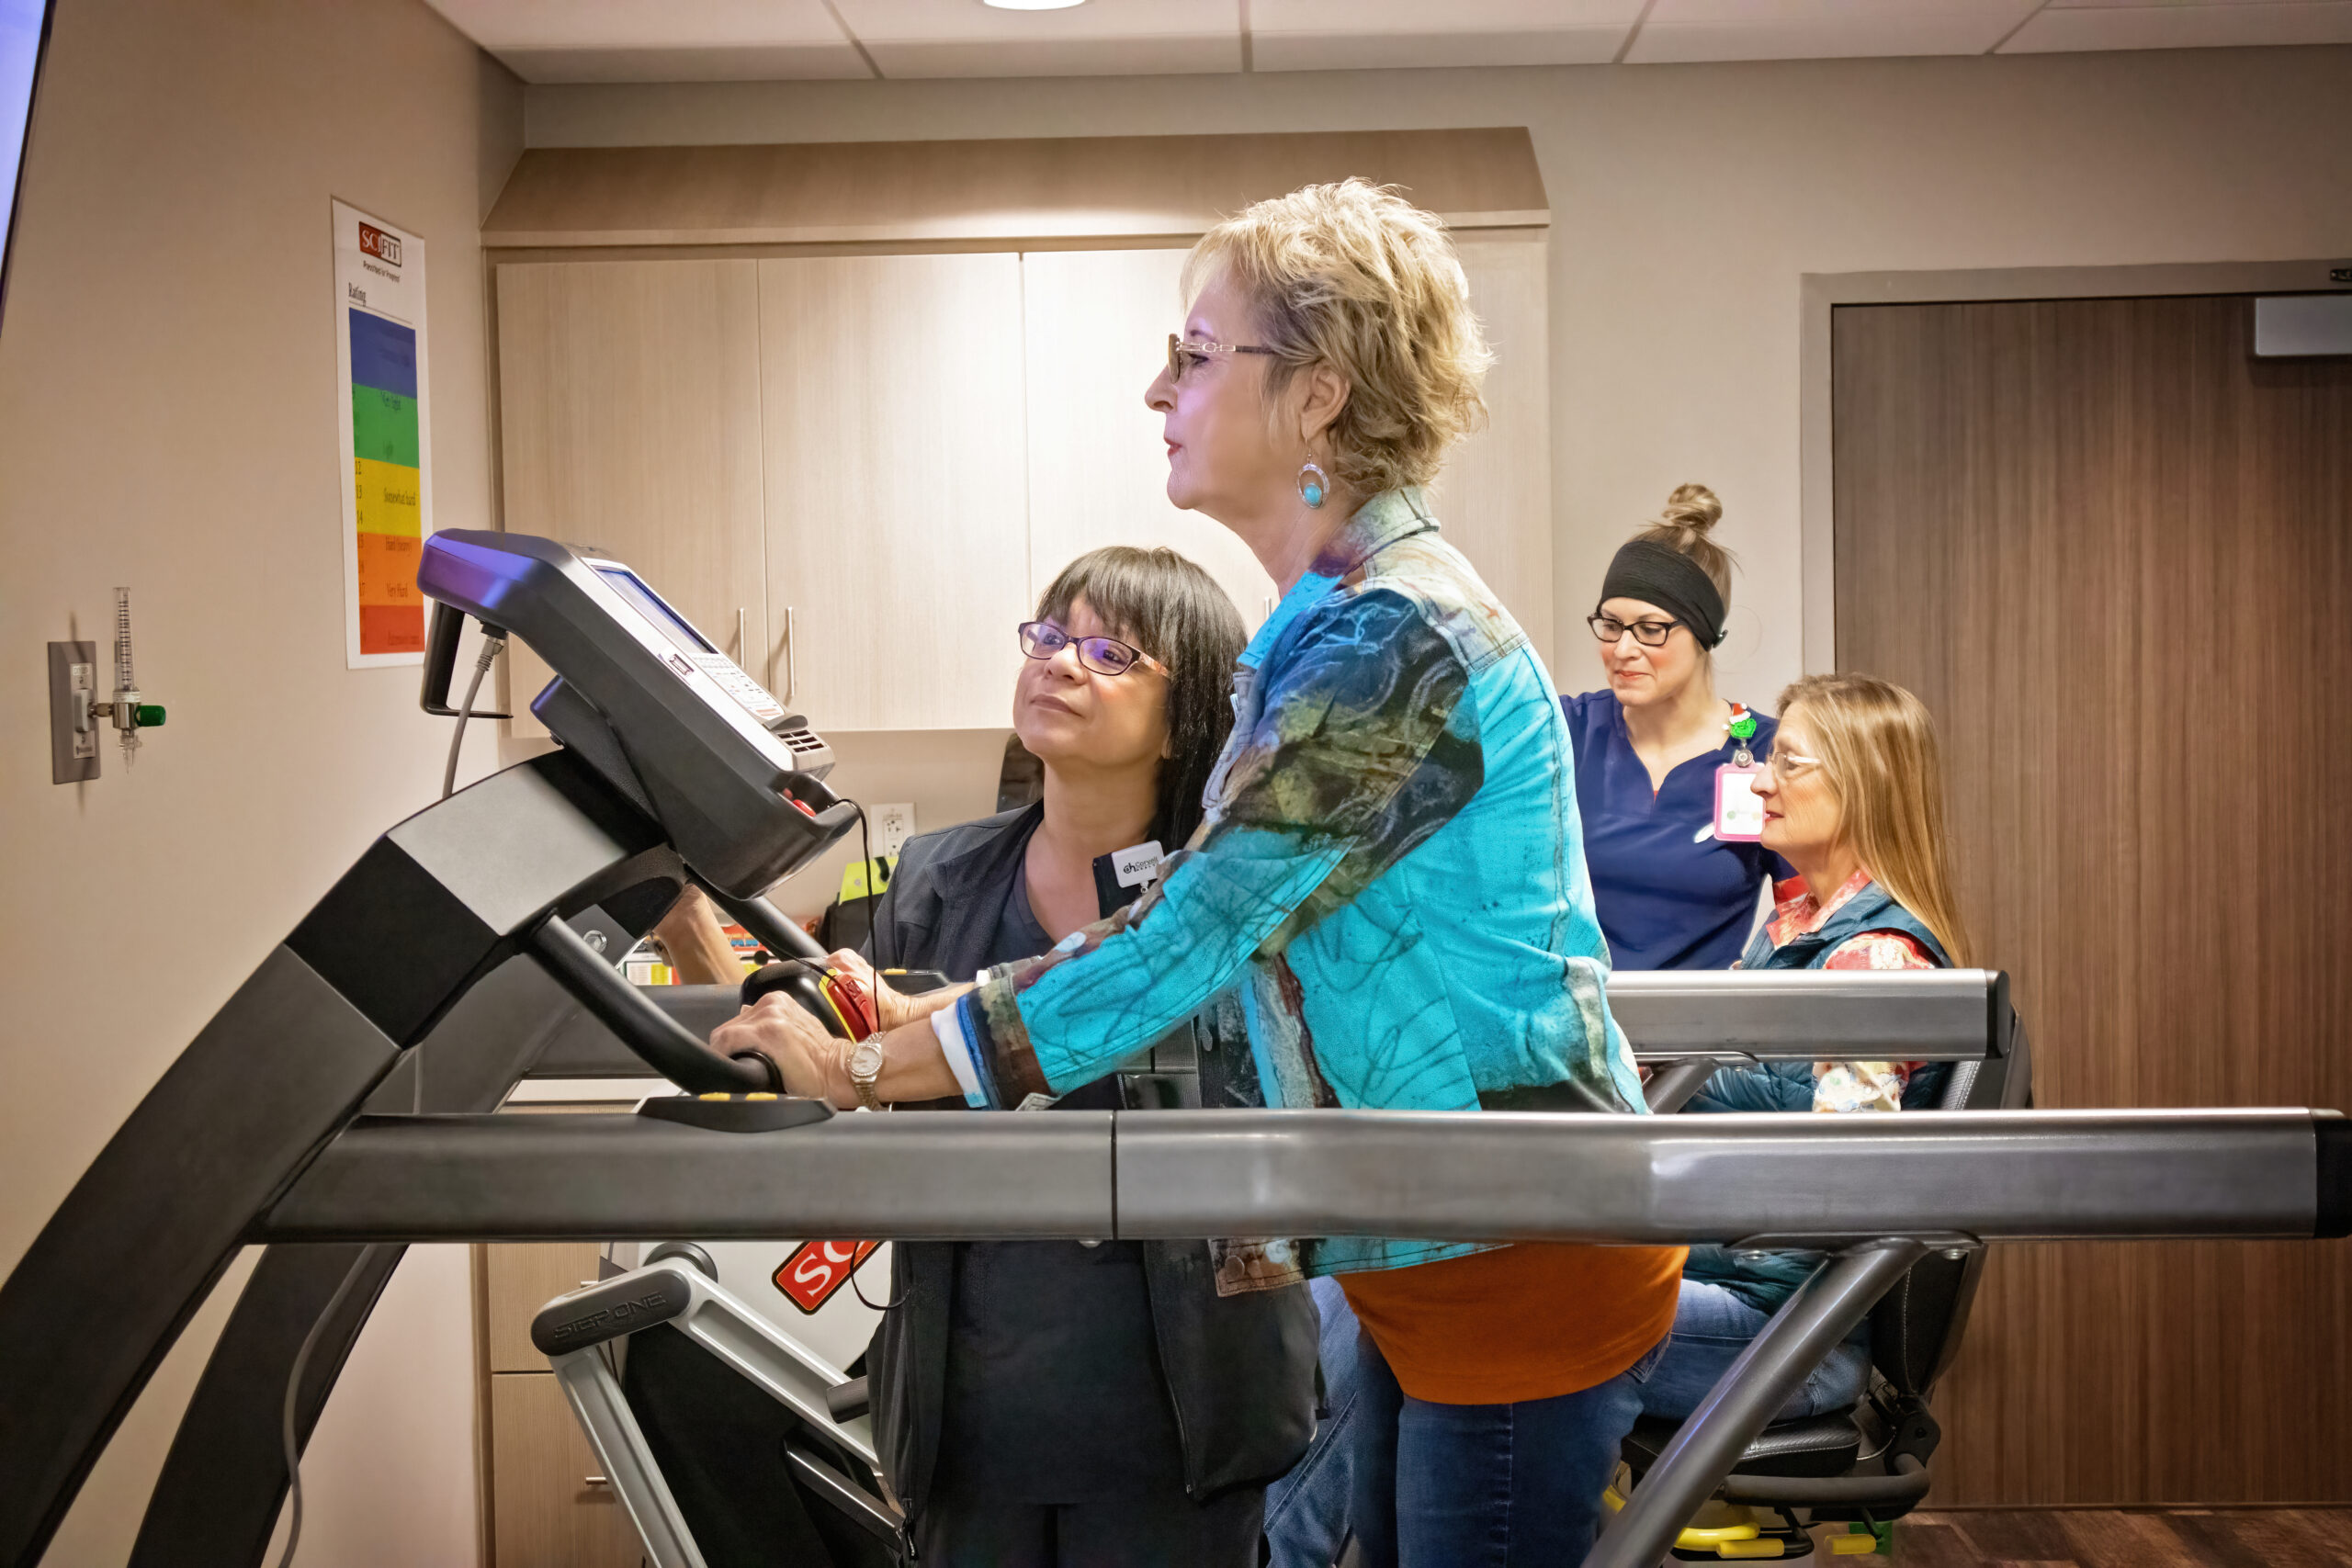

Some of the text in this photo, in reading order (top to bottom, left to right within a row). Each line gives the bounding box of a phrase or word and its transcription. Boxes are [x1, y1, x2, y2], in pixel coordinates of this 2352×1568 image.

[362, 230, 399, 260] SCIFIT
[349, 281, 367, 308] Rating
[553, 1291, 667, 1338] STEP ONE
